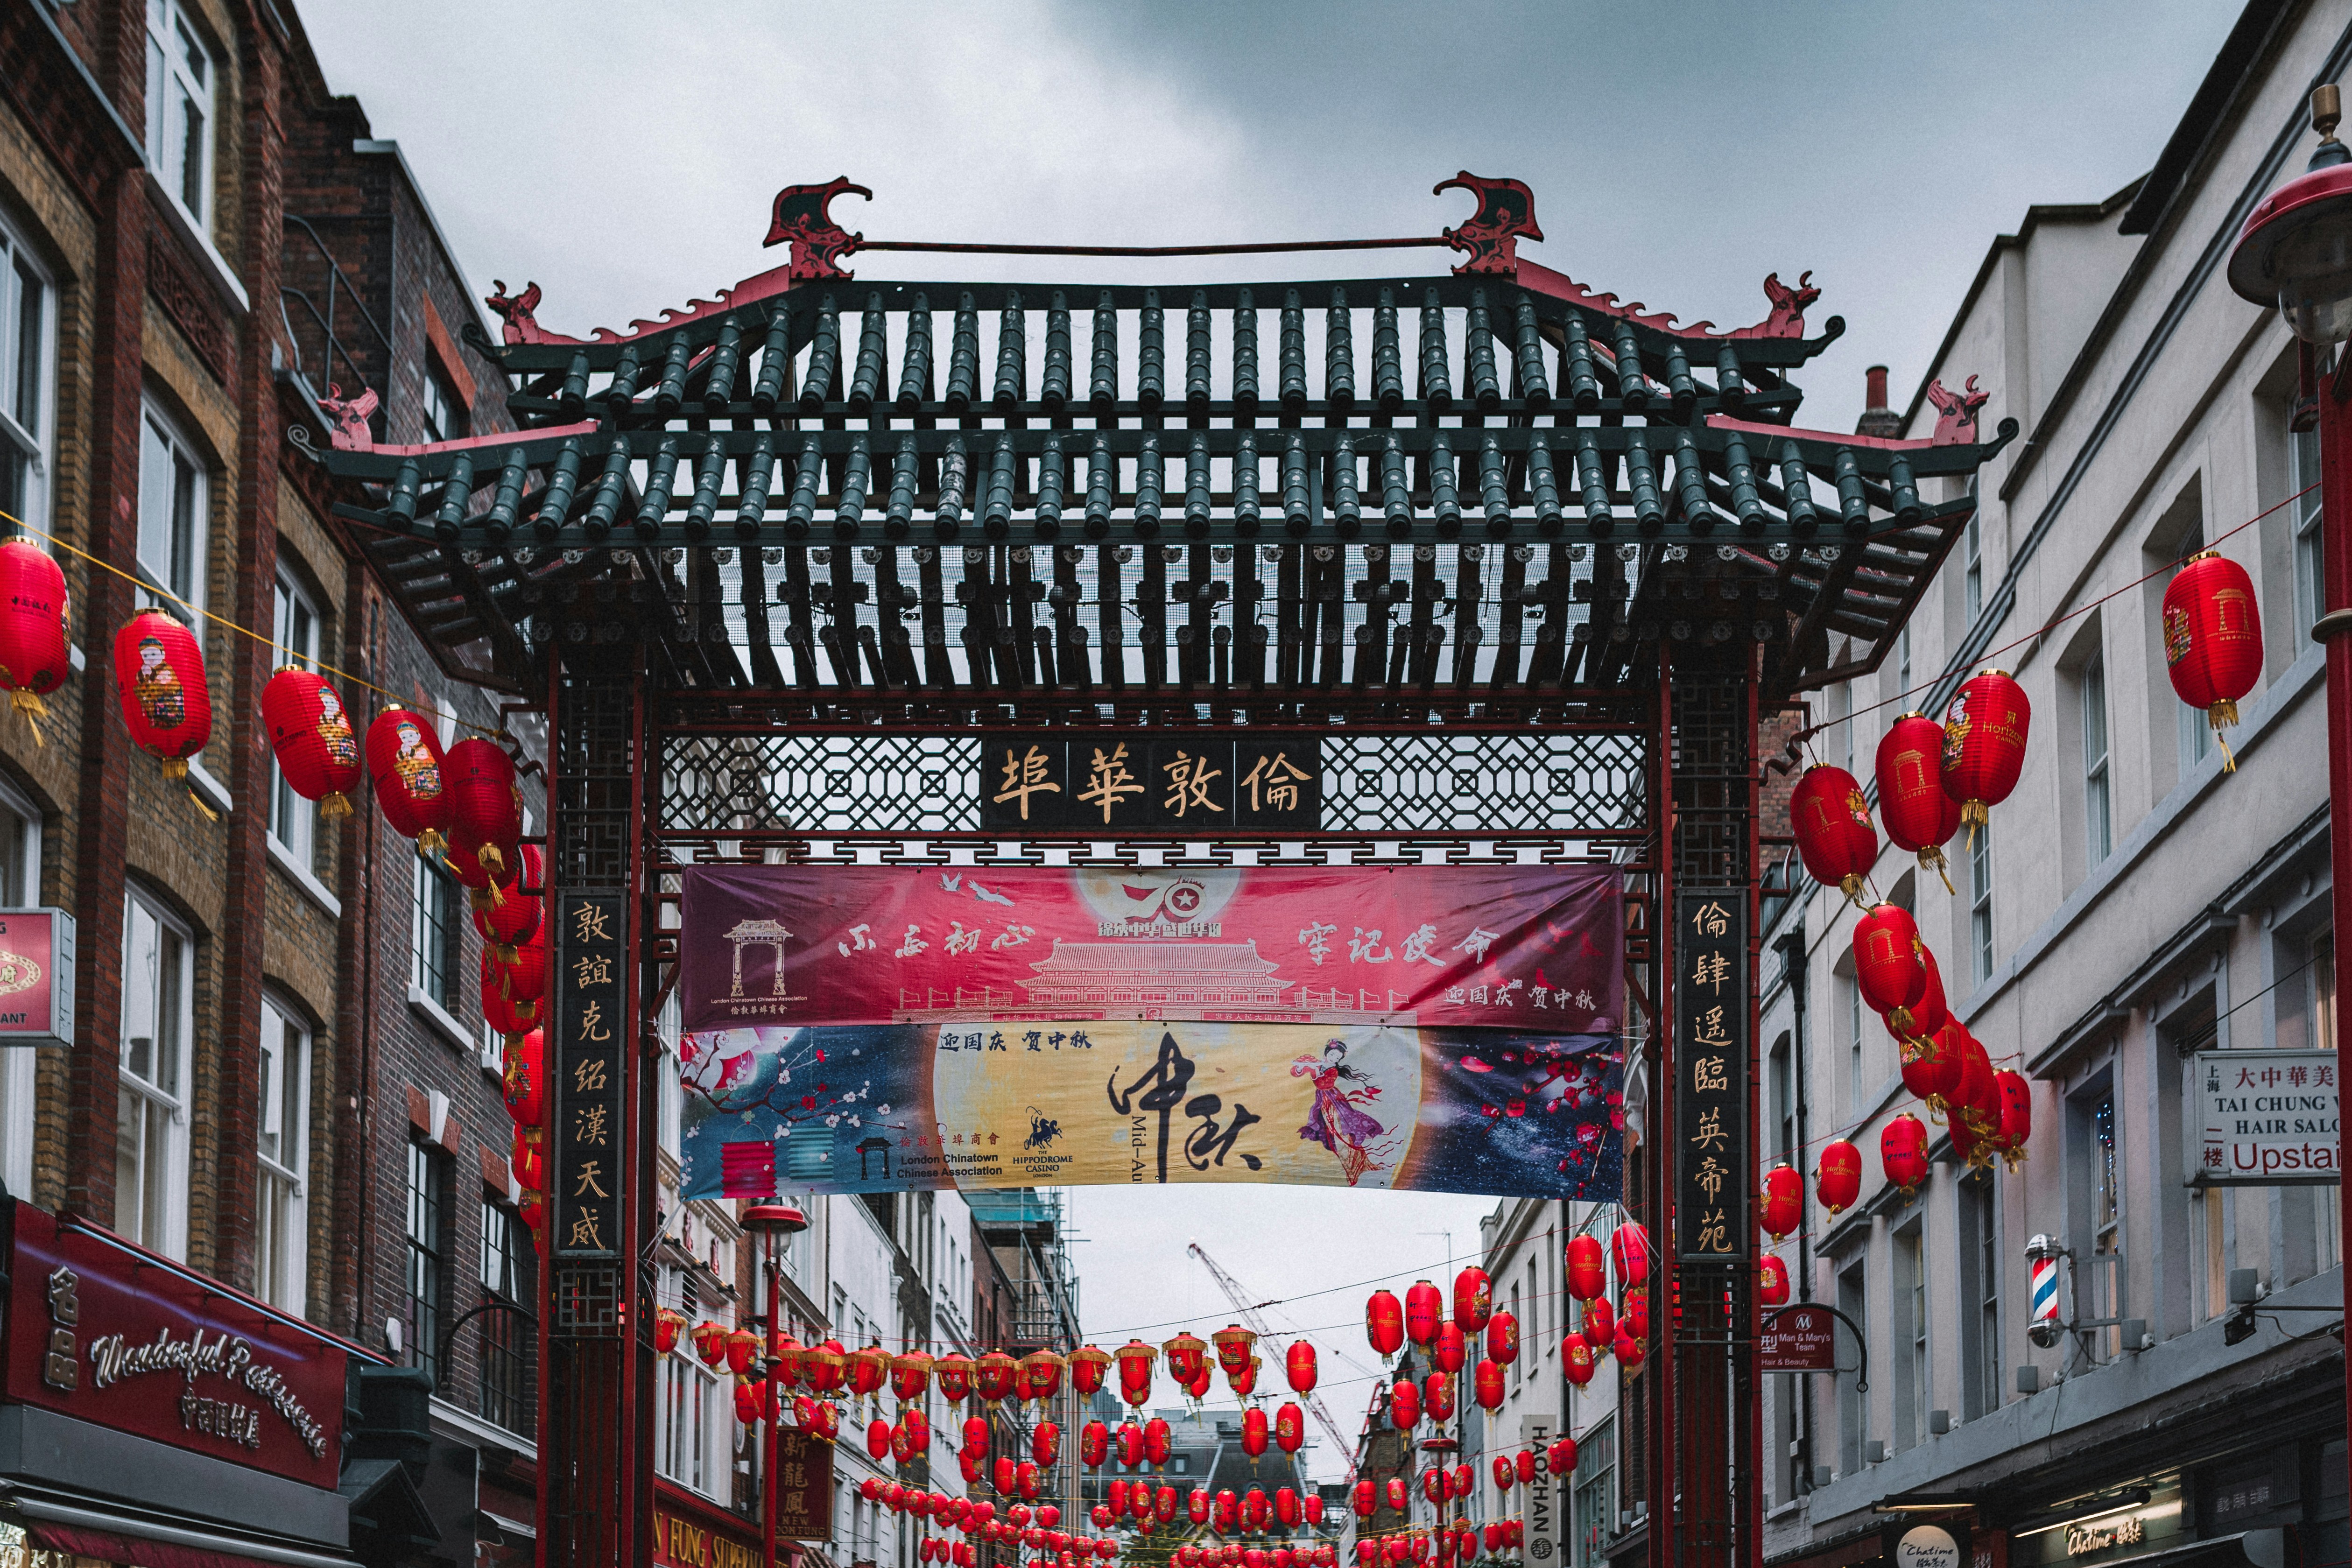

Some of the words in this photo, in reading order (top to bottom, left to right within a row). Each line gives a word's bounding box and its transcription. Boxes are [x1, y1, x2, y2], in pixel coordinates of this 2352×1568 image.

[2206, 1065, 2220, 1093] 上海
[2215, 1097, 2247, 1112] TAI
[2254, 1096, 2326, 1112] CHUNG
[2235, 1119, 2288, 1134] HAIR
[1132, 1115, 1147, 1184] Mid-Au
[901, 1155, 940, 1165] London
[943, 1153, 999, 1164] Chinatown
[1013, 1155, 1073, 1164] HIPPODROME
[897, 1168, 938, 1178] Chinese
[941, 1166, 1003, 1177] Association
[1779, 1333, 1796, 1342] Man
[1798, 1333, 1803, 1342] &
[1806, 1333, 1831, 1343] Mary's
[1795, 1343, 1815, 1351] Team
[91, 1327, 228, 1388] Wonderful
[1532, 1427, 1549, 1532] HAOZHAN
[782, 1516, 810, 1526] NEW
[669, 1518, 706, 1568] FUNG
[2068, 1528, 2112, 1556] Chatime
[1907, 1546, 1954, 1556] Chatime
